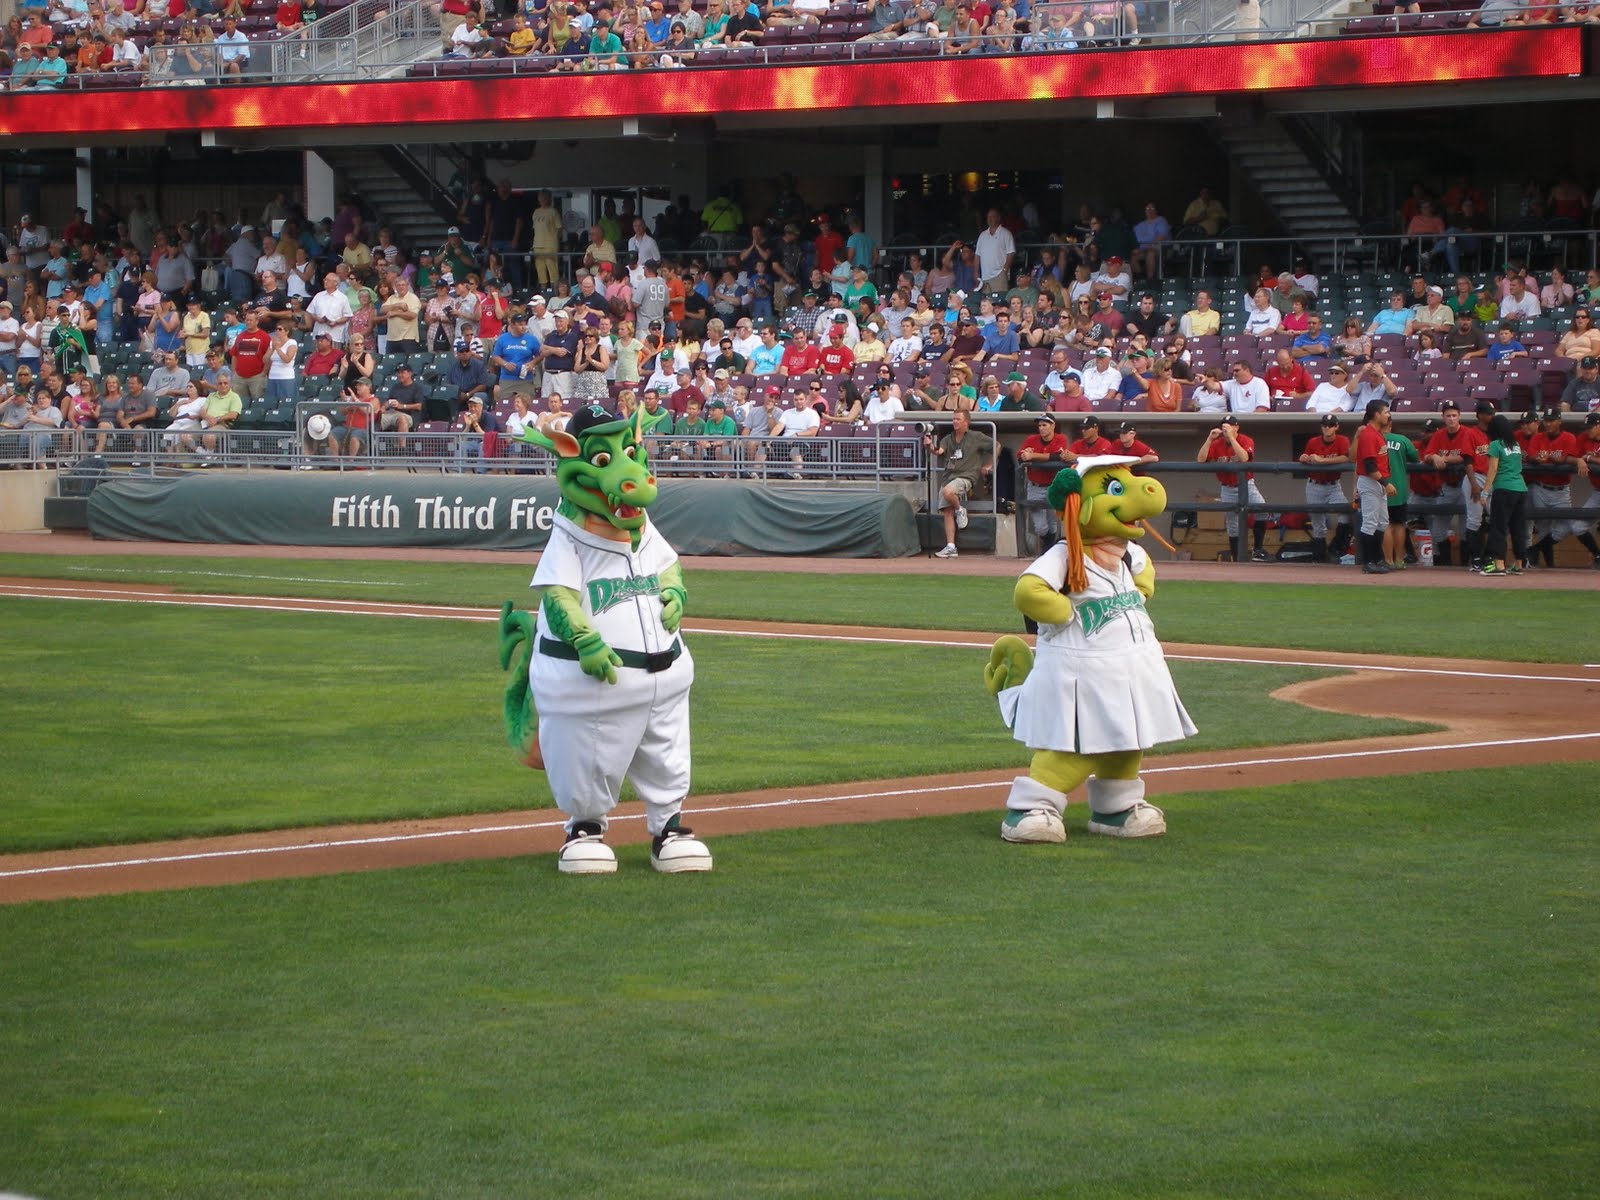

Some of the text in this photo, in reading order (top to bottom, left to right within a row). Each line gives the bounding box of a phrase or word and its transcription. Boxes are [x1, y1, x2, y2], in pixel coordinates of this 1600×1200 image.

[650, 284, 665, 301] 99
[1386, 440, 1401, 451] ALD
[332, 494, 400, 528] Fifth
[414, 496, 497, 530] Third
